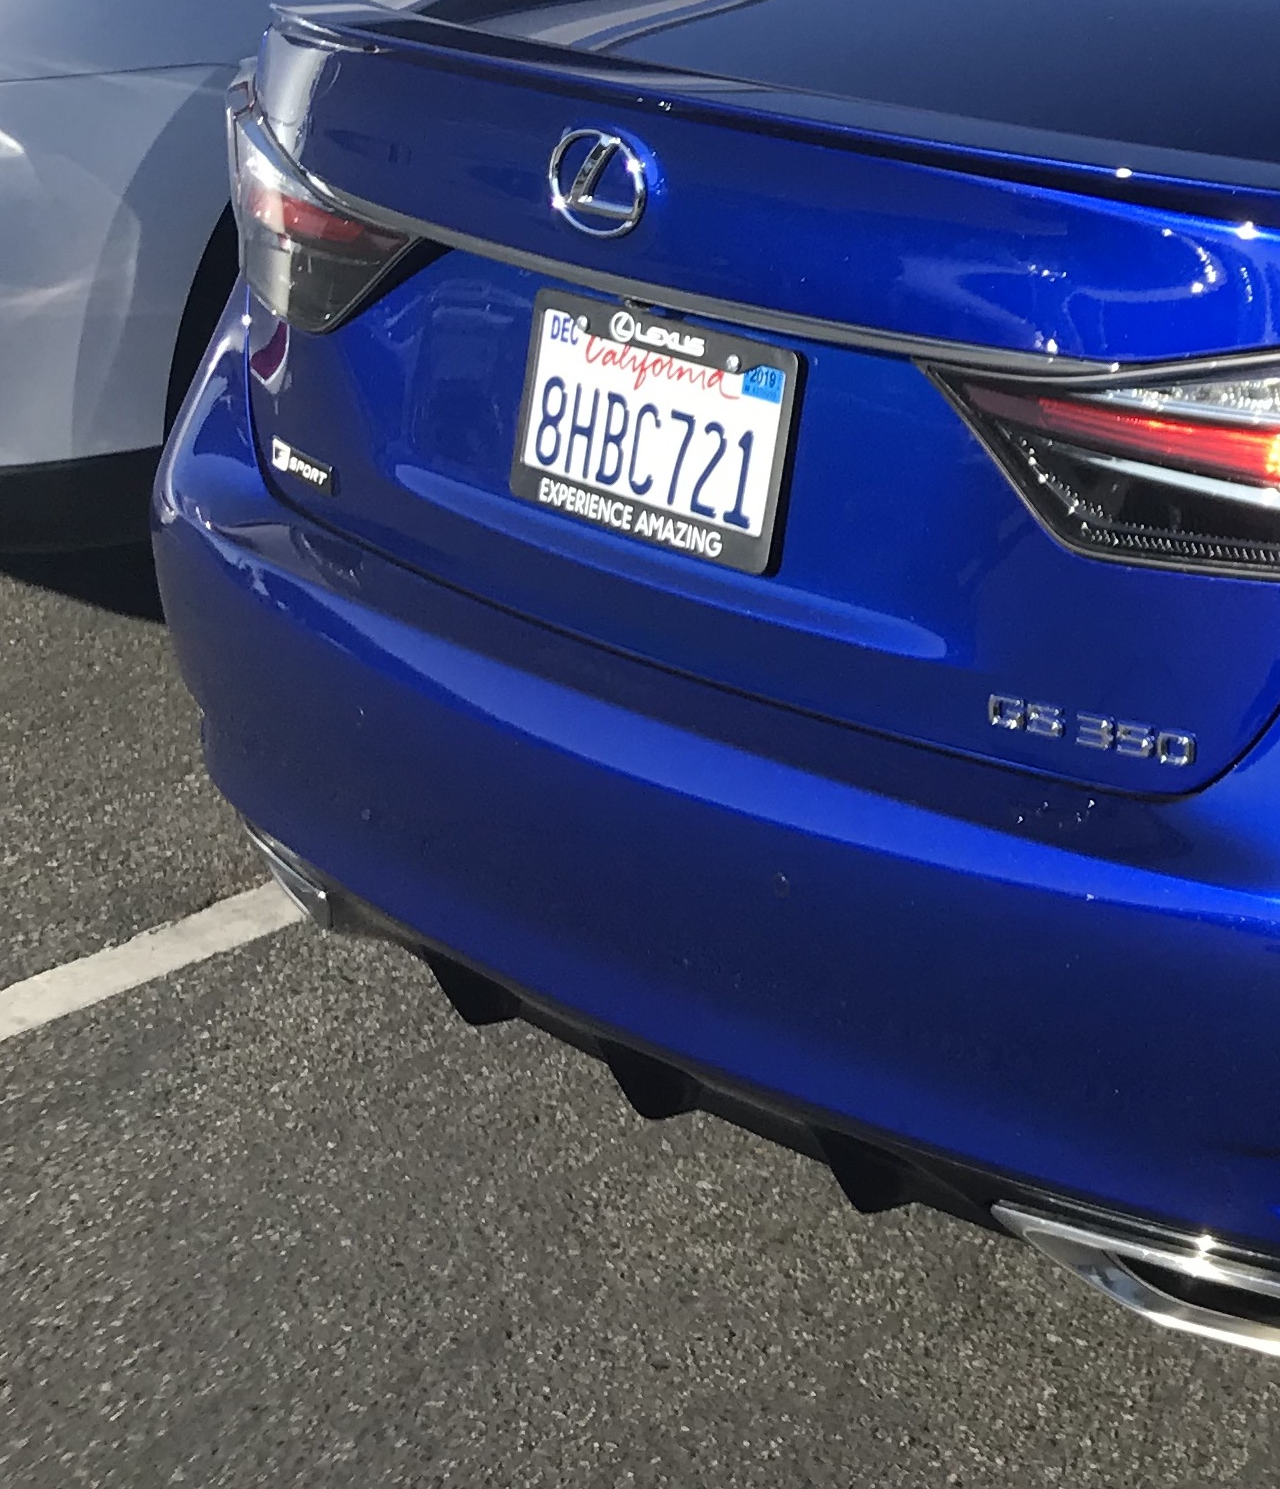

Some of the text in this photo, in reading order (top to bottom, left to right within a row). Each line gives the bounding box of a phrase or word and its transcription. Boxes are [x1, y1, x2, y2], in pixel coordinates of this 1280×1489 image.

[550, 314, 580, 346] DEC
[634, 322, 706, 357] LEXUS
[584, 334, 740, 400] California
[749, 368, 777, 389] 2019
[289, 456, 328, 486] SPORT
[535, 375, 755, 529] 8HBC721
[538, 476, 723, 558] EXPERIENCE AMAZING
[988, 693, 1198, 766] GS 350
